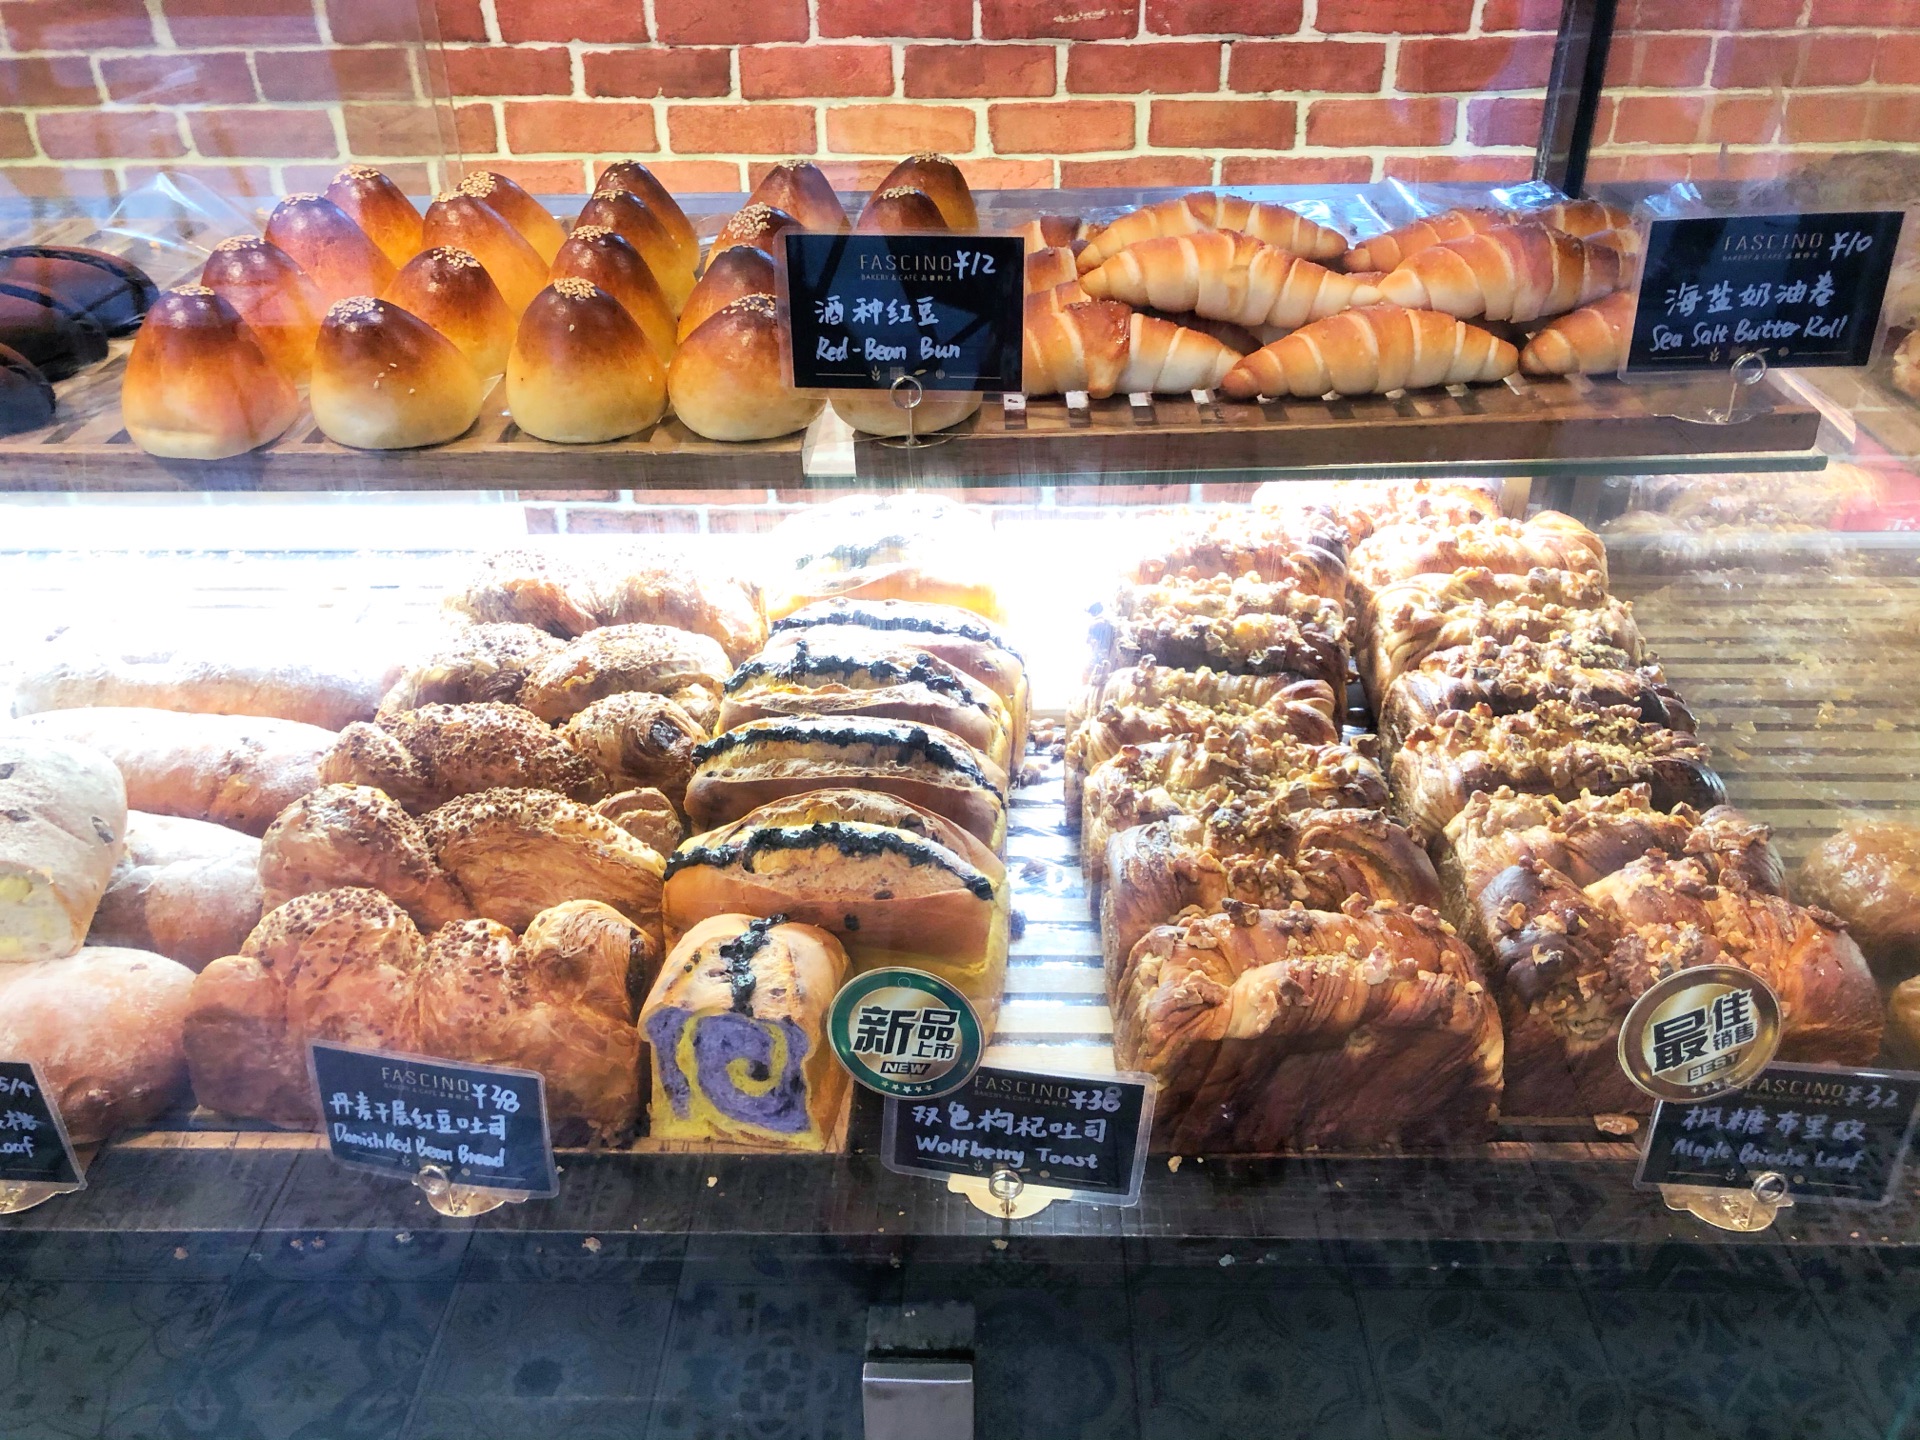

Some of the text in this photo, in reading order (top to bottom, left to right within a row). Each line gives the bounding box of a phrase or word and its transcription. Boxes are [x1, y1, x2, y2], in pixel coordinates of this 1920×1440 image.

[1723, 232, 1824, 252] FASCINO
[1829, 231, 1873, 261] ¥10
[860, 254, 952, 271] FASCINO
[953, 250, 997, 281] ¥12
[1664, 270, 1837, 316] 海盐奶油卷
[814, 295, 940, 327] 酒种红豆
[1650, 315, 1848, 352] Sea Salt Butter Roll
[920, 336, 961, 360] Bun
[853, 1005, 959, 1056] 新品
[1651, 991, 1751, 1074] 最佳
[1712, 1021, 1756, 1051] 销售
[911, 1042, 956, 1060] 上市
[381, 1066, 470, 1094] FASCINO
[883, 1062, 927, 1076] NEW
[1689, 1053, 1739, 1081] BEST
[974, 1075, 1070, 1100] FASCINO
[1069, 1086, 1123, 1113] ¥38
[1746, 1078, 1845, 1098] FASCINO
[911, 1101, 1107, 1143] 双色枸杞吐司
[458, 1144, 506, 1167] Bread
[915, 1134, 1099, 1170] Wolfberry Toast
[1671, 1138, 1733, 1166] Maple
